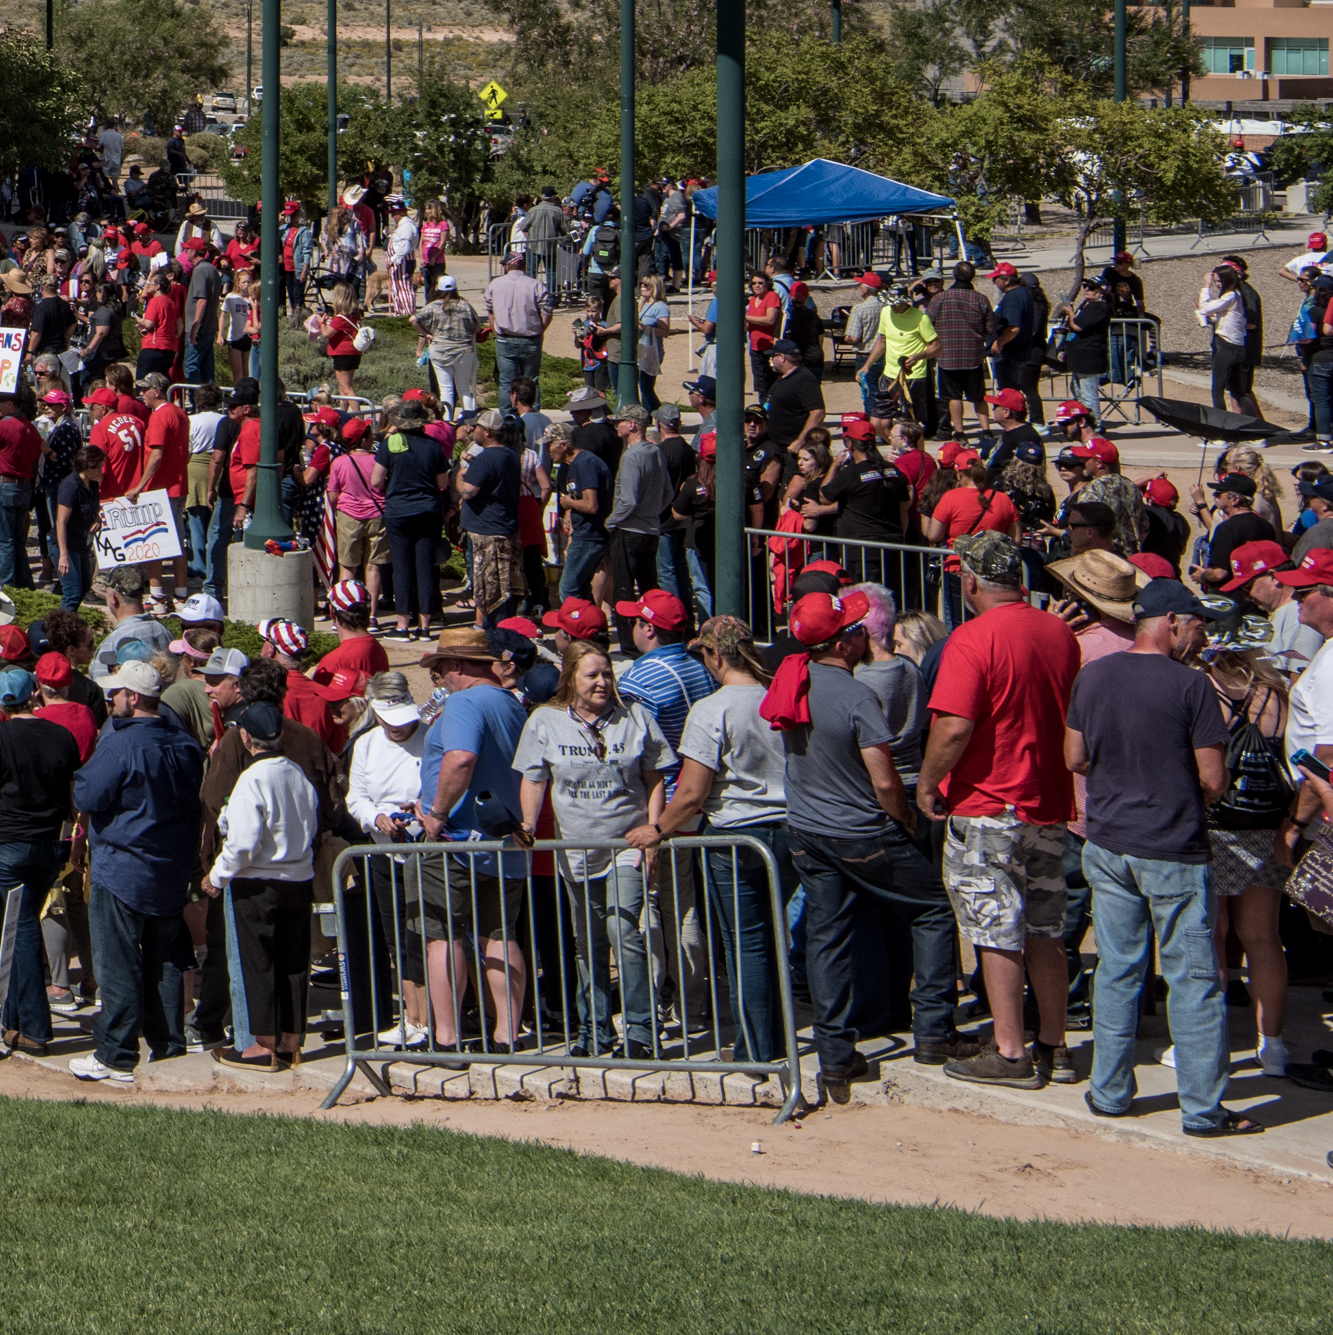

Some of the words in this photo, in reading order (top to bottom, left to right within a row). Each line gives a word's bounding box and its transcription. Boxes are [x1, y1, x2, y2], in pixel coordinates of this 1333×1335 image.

[117, 425, 142, 452] 51
[94, 530, 126, 561] KAG
[126, 542, 161, 562] 2020
[580, 790, 590, 798] THE
[592, 790, 606, 798] LAST
